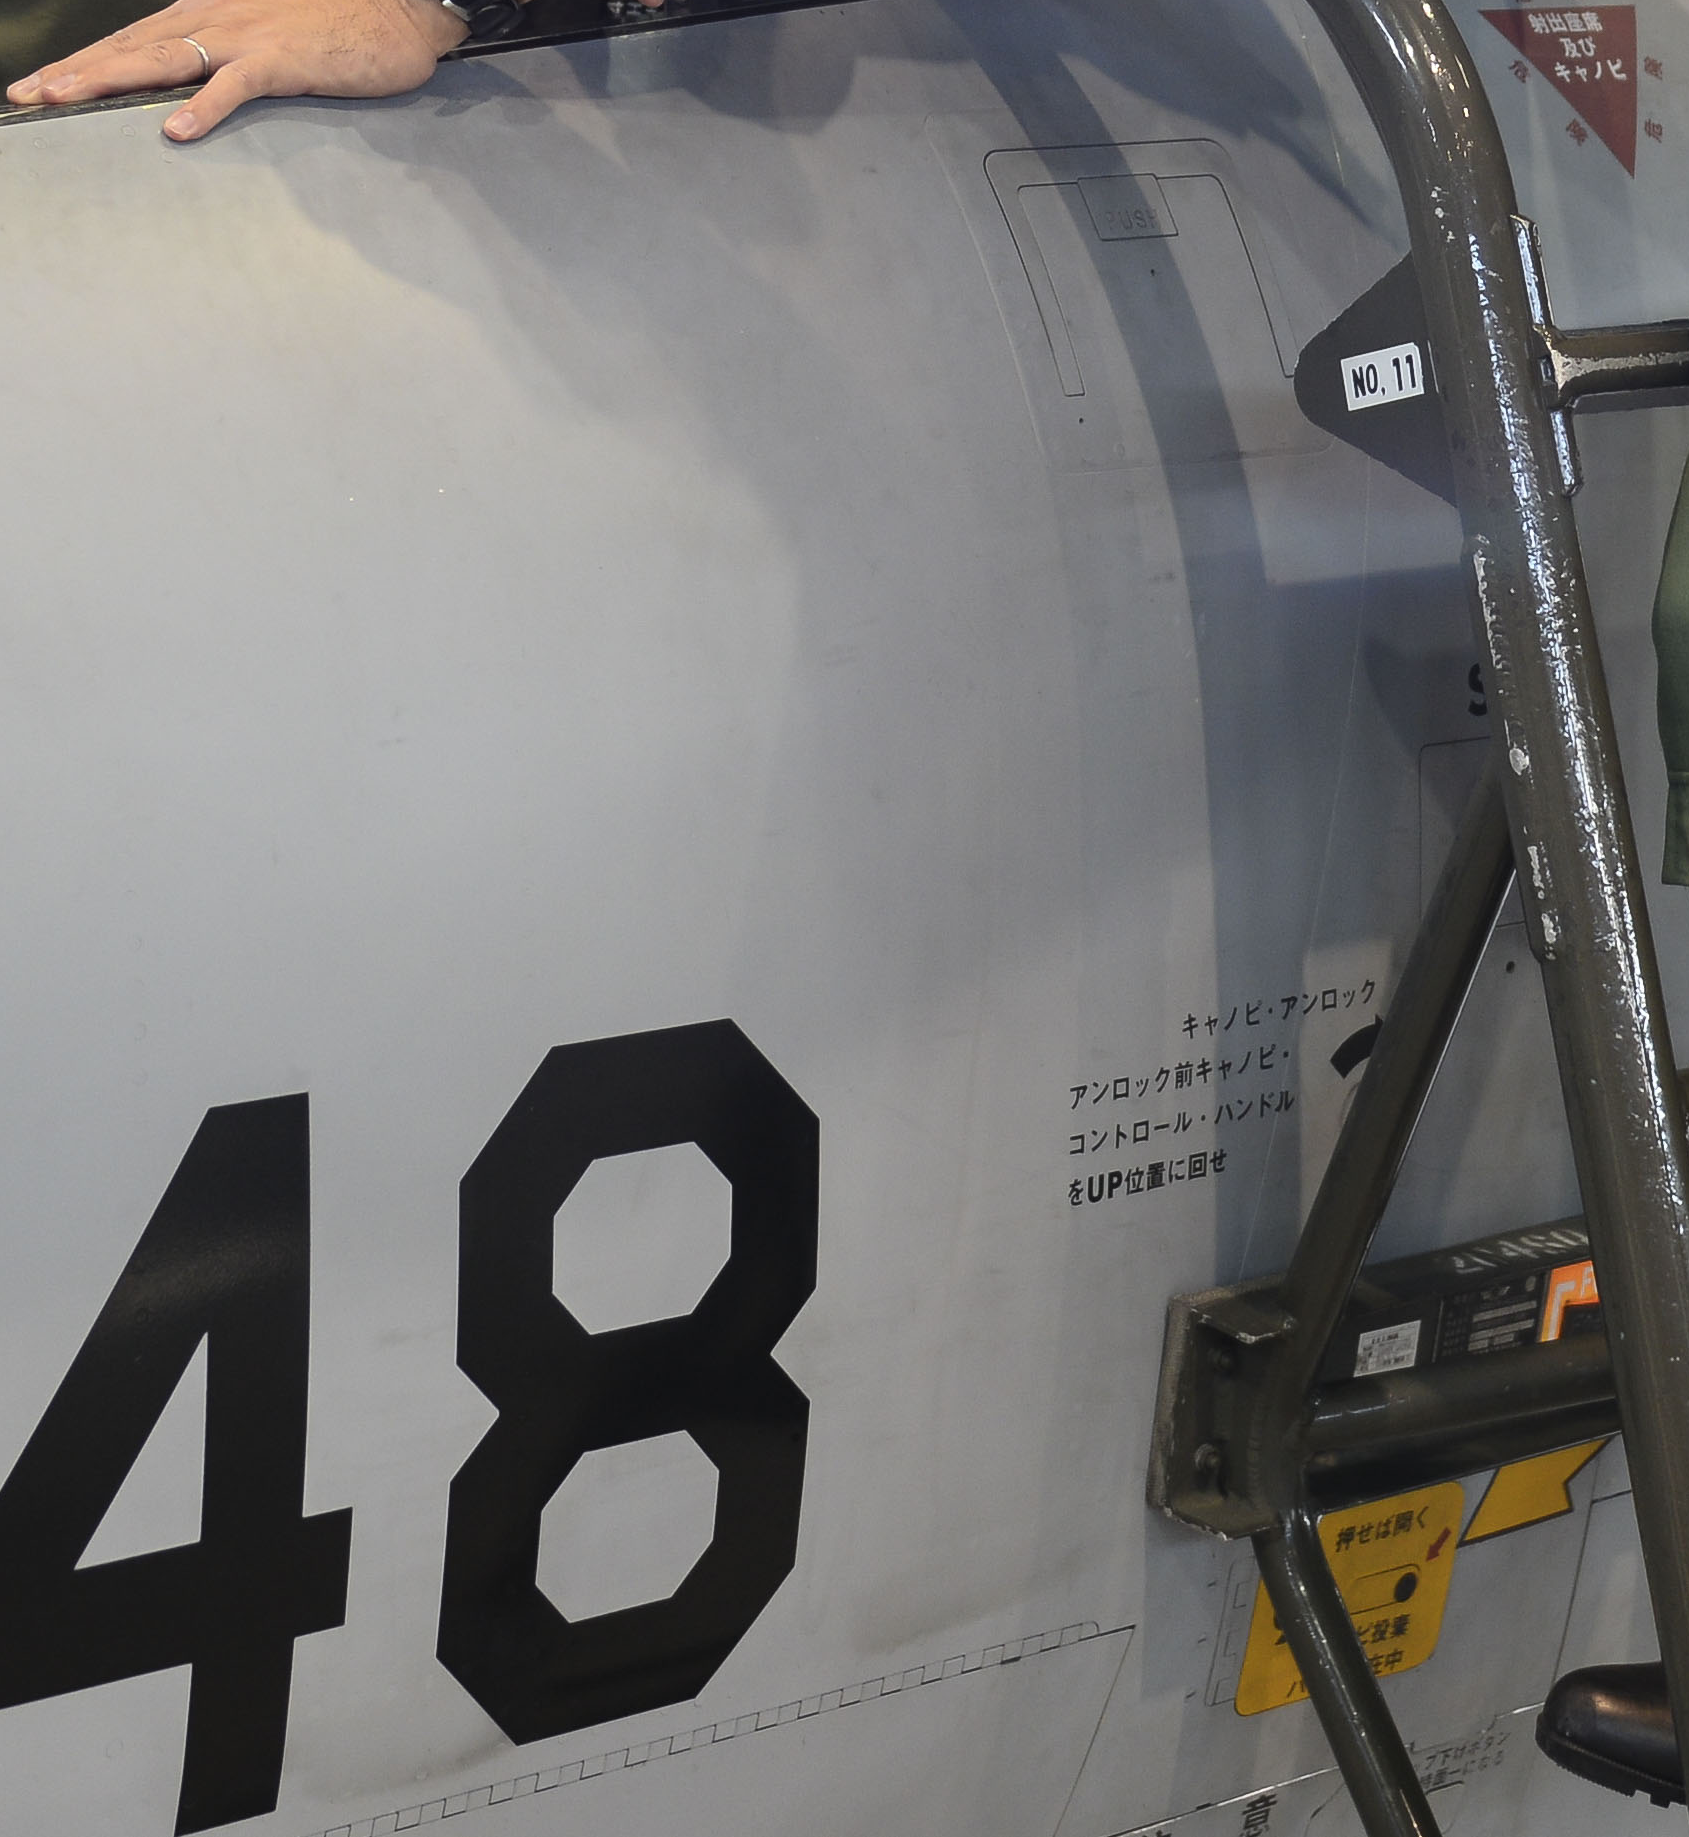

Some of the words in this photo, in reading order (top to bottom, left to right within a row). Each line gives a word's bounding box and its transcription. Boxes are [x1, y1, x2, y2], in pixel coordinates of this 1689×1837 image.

[1558, 35, 1597, 59] 及び
[1105, 207, 1161, 232] PUSH
[1392, 354, 1417, 392] 11
[1068, 1090, 1296, 1156] コントロール・ハンドル
[1067, 1147, 1228, 1207] をUP位置に回せ
